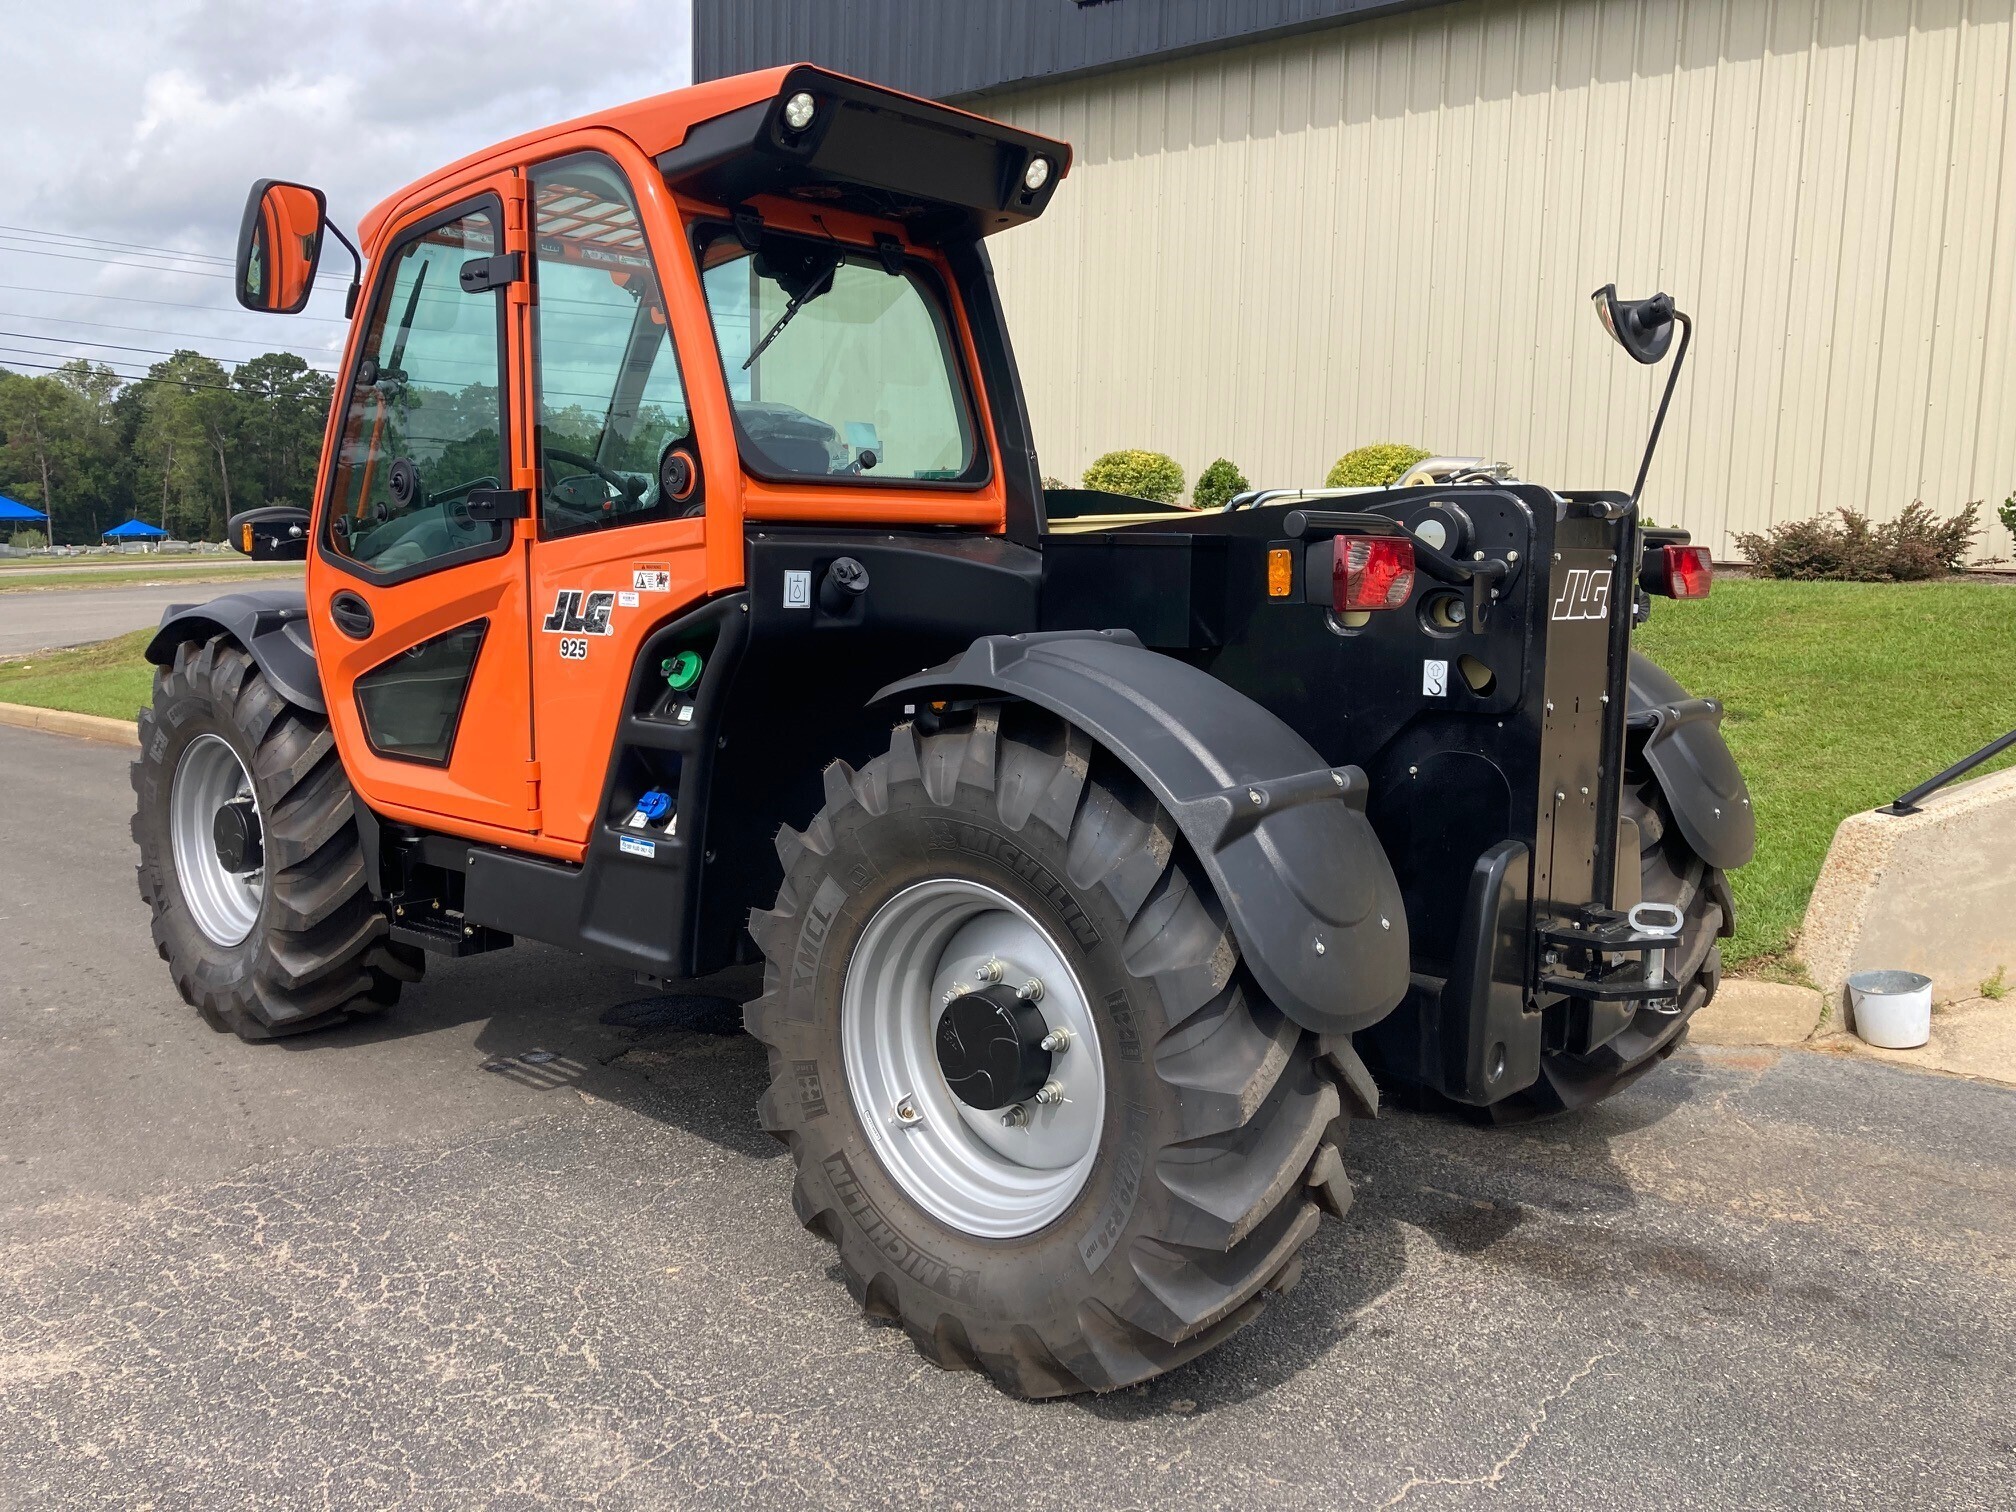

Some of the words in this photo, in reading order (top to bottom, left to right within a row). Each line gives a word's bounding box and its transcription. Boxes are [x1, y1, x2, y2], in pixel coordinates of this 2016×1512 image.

[543, 590, 614, 635] JLG
[1552, 569, 1612, 620] JLG
[560, 638, 588, 659] 925
[957, 824, 1100, 946] MICHELIN
[793, 905, 833, 991] XMCL
[821, 1157, 944, 1287] MICHELIN
